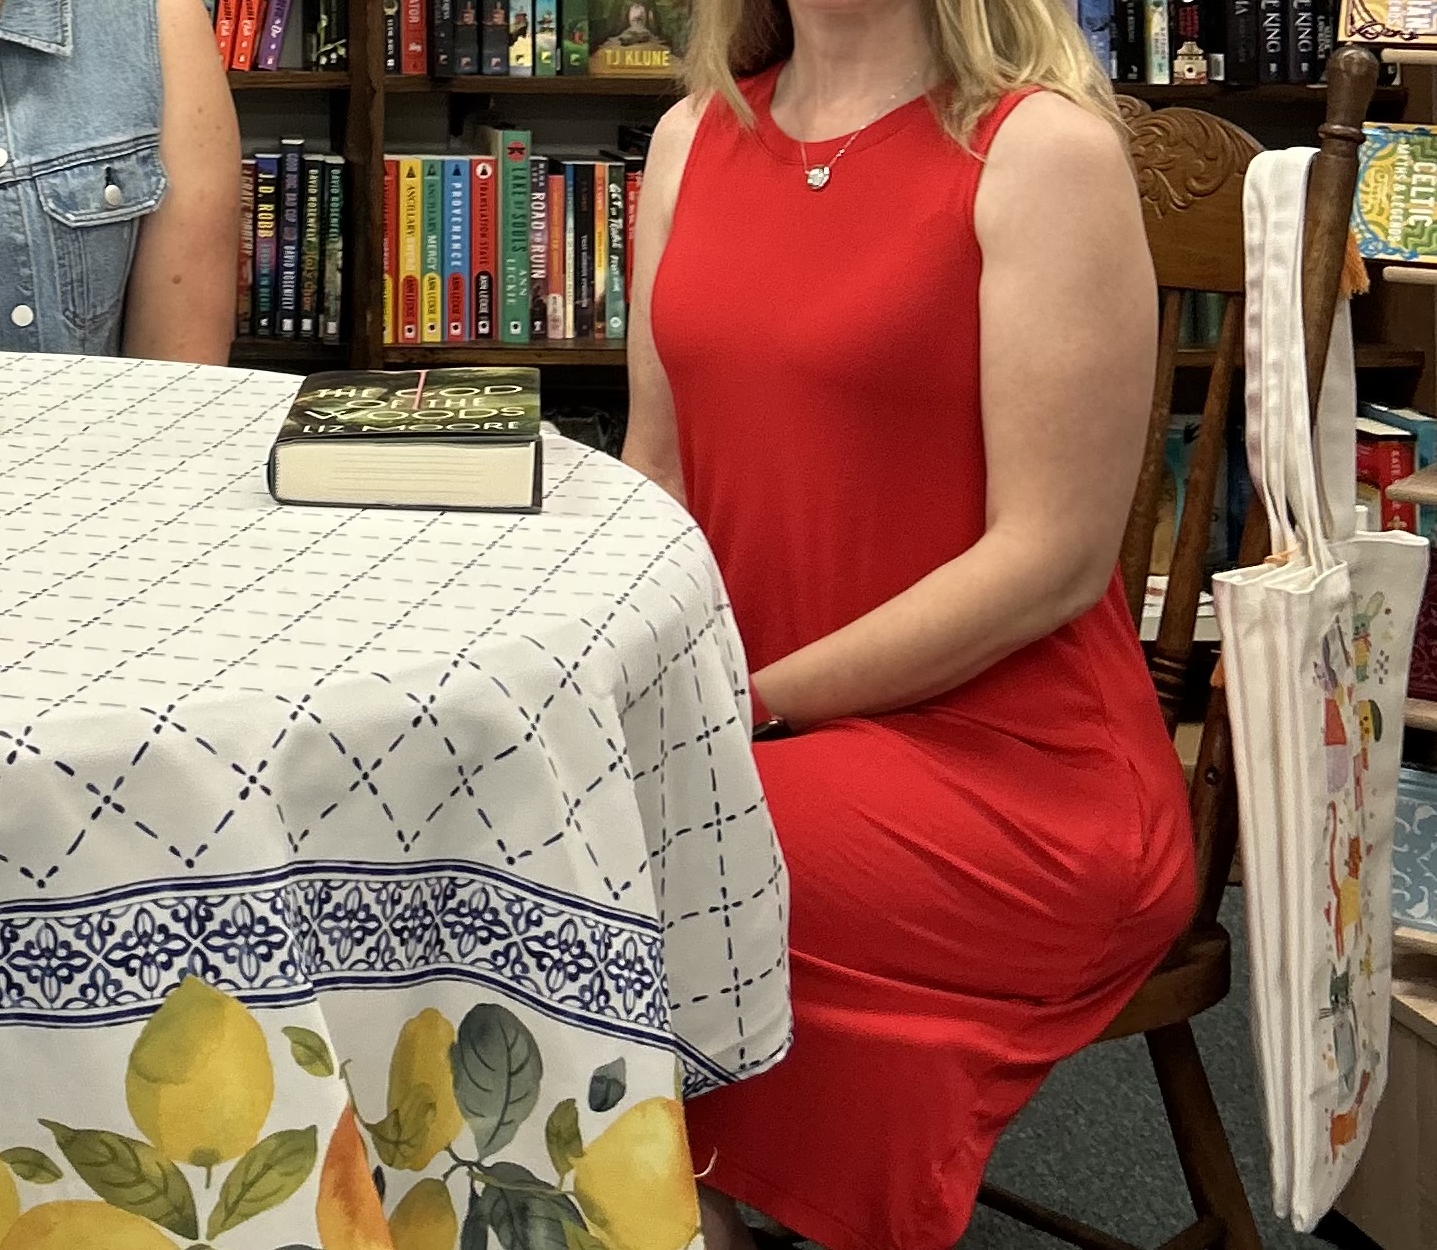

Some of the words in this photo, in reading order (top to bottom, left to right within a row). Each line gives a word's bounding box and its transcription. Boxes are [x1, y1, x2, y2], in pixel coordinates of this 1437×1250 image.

[1410, 162, 1434, 227] CELTIC
[531, 192, 545, 230] ROAD
[451, 182, 461, 267] PROVENANCE
[531, 245, 545, 279] RUIN
[317, 388, 373, 398] THE
[395, 385, 523, 398] GOD
[345, 400, 402, 408] OF
[427, 398, 485, 408] THE
[304, 407, 525, 420] WOODS
[302, 425, 344, 433] LIZ
[361, 421, 520, 431] MOORE
